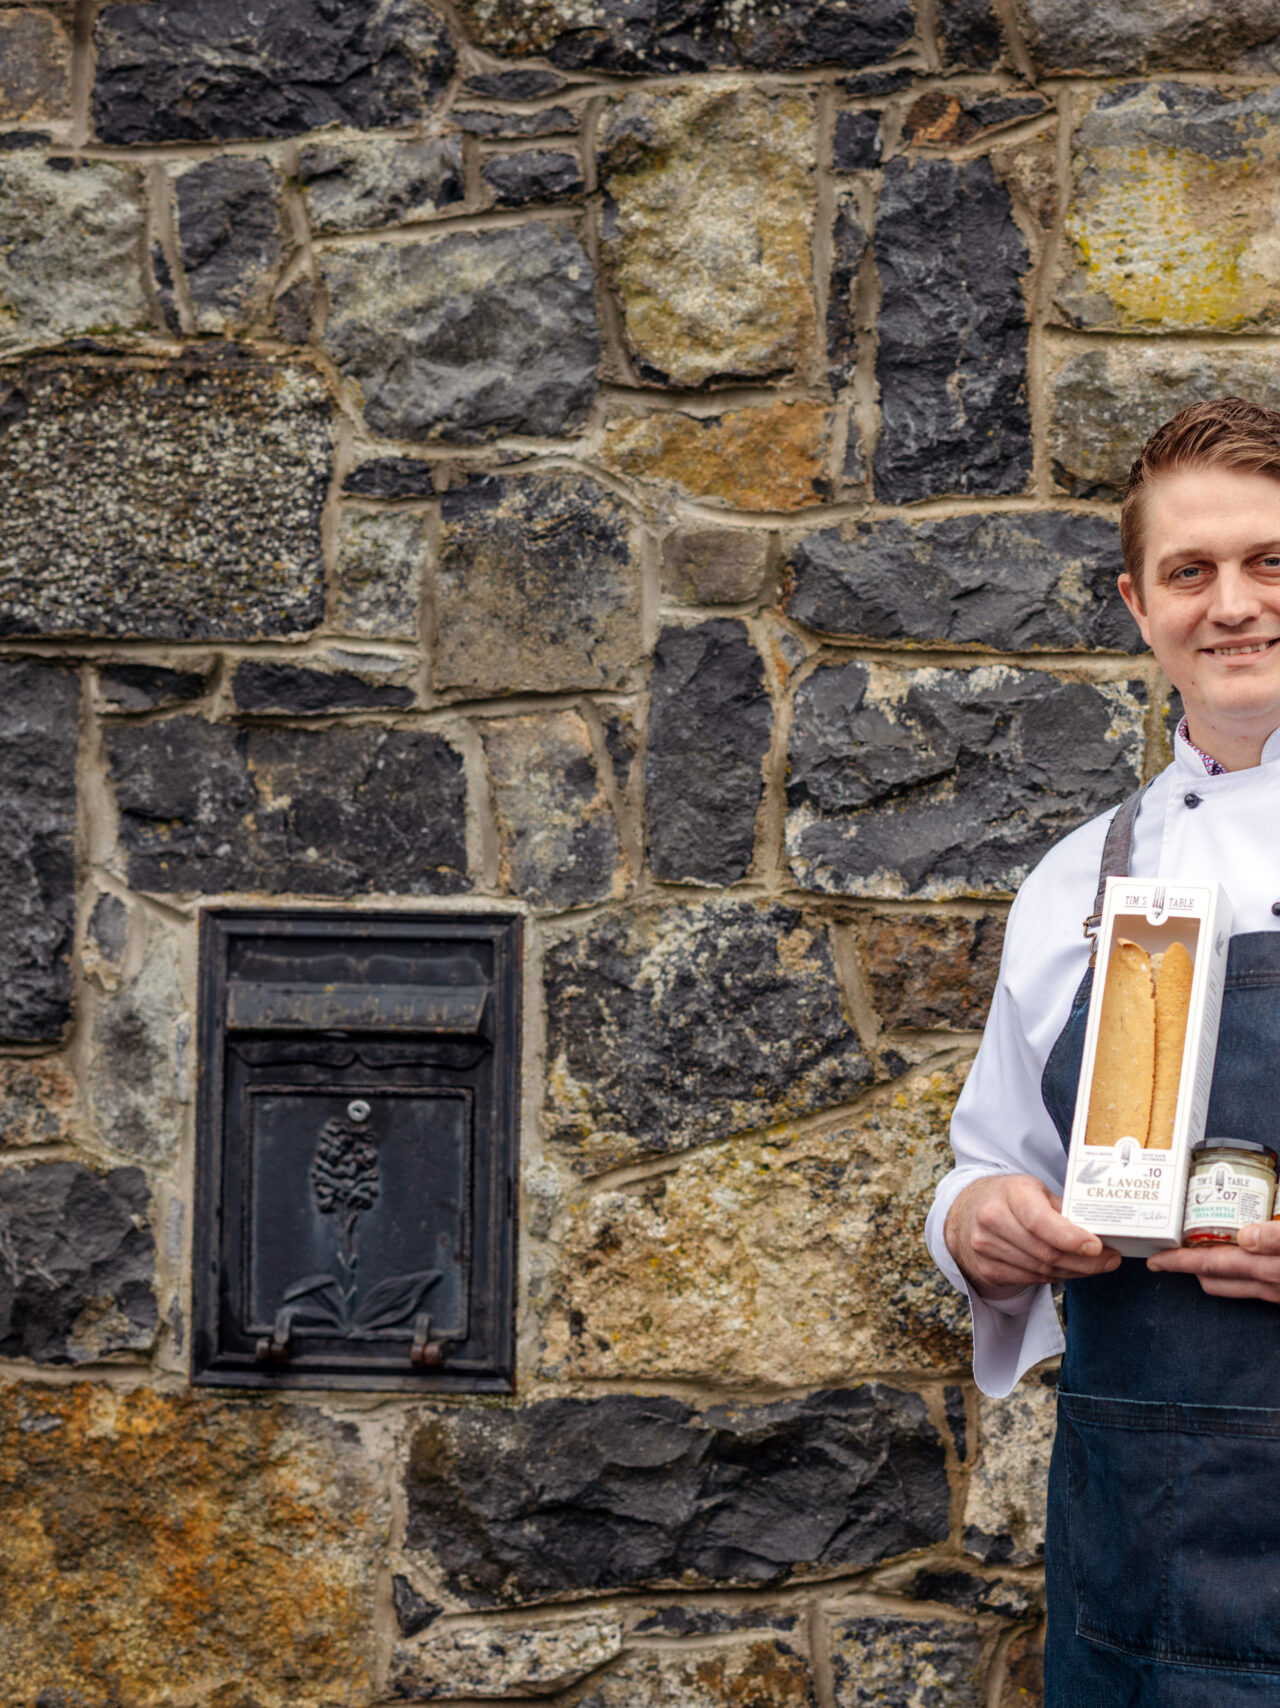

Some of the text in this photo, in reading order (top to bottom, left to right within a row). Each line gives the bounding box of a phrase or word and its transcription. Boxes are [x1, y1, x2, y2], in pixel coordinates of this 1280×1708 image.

[1125, 895, 1195, 908] TIM'S TABLE
[1148, 1167, 1162, 1178] 10
[1107, 1177, 1161, 1190] LAVOSH
[1227, 1176, 1250, 1187] TABLE
[1087, 1187, 1160, 1201] CRACKERS
[1222, 1191, 1237, 1201] 07
